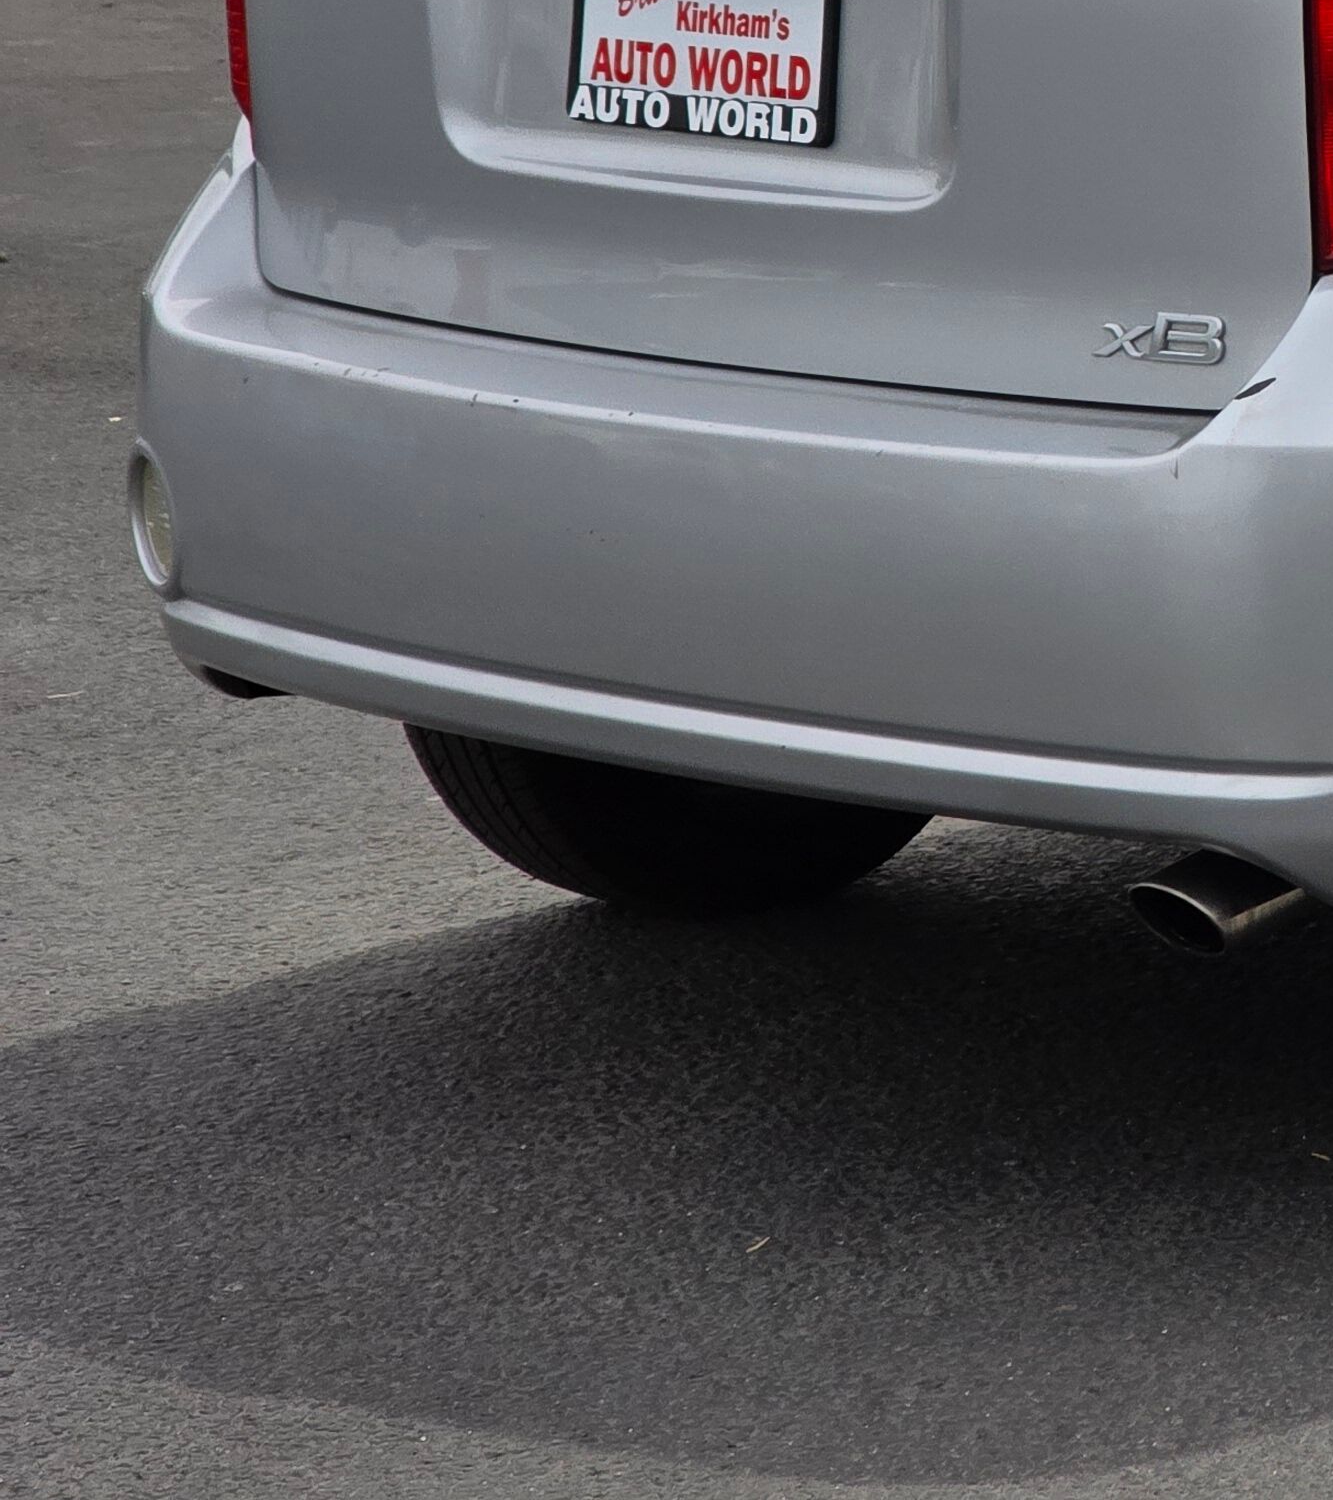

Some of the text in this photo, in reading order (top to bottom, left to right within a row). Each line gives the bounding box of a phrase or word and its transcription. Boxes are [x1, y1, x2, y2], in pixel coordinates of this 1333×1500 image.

[676, 0, 790, 41] Kirkham's
[591, 37, 811, 100] AUTO WORLD
[569, 84, 817, 144] AUTO WORLD
[1092, 311, 1226, 365] xB
